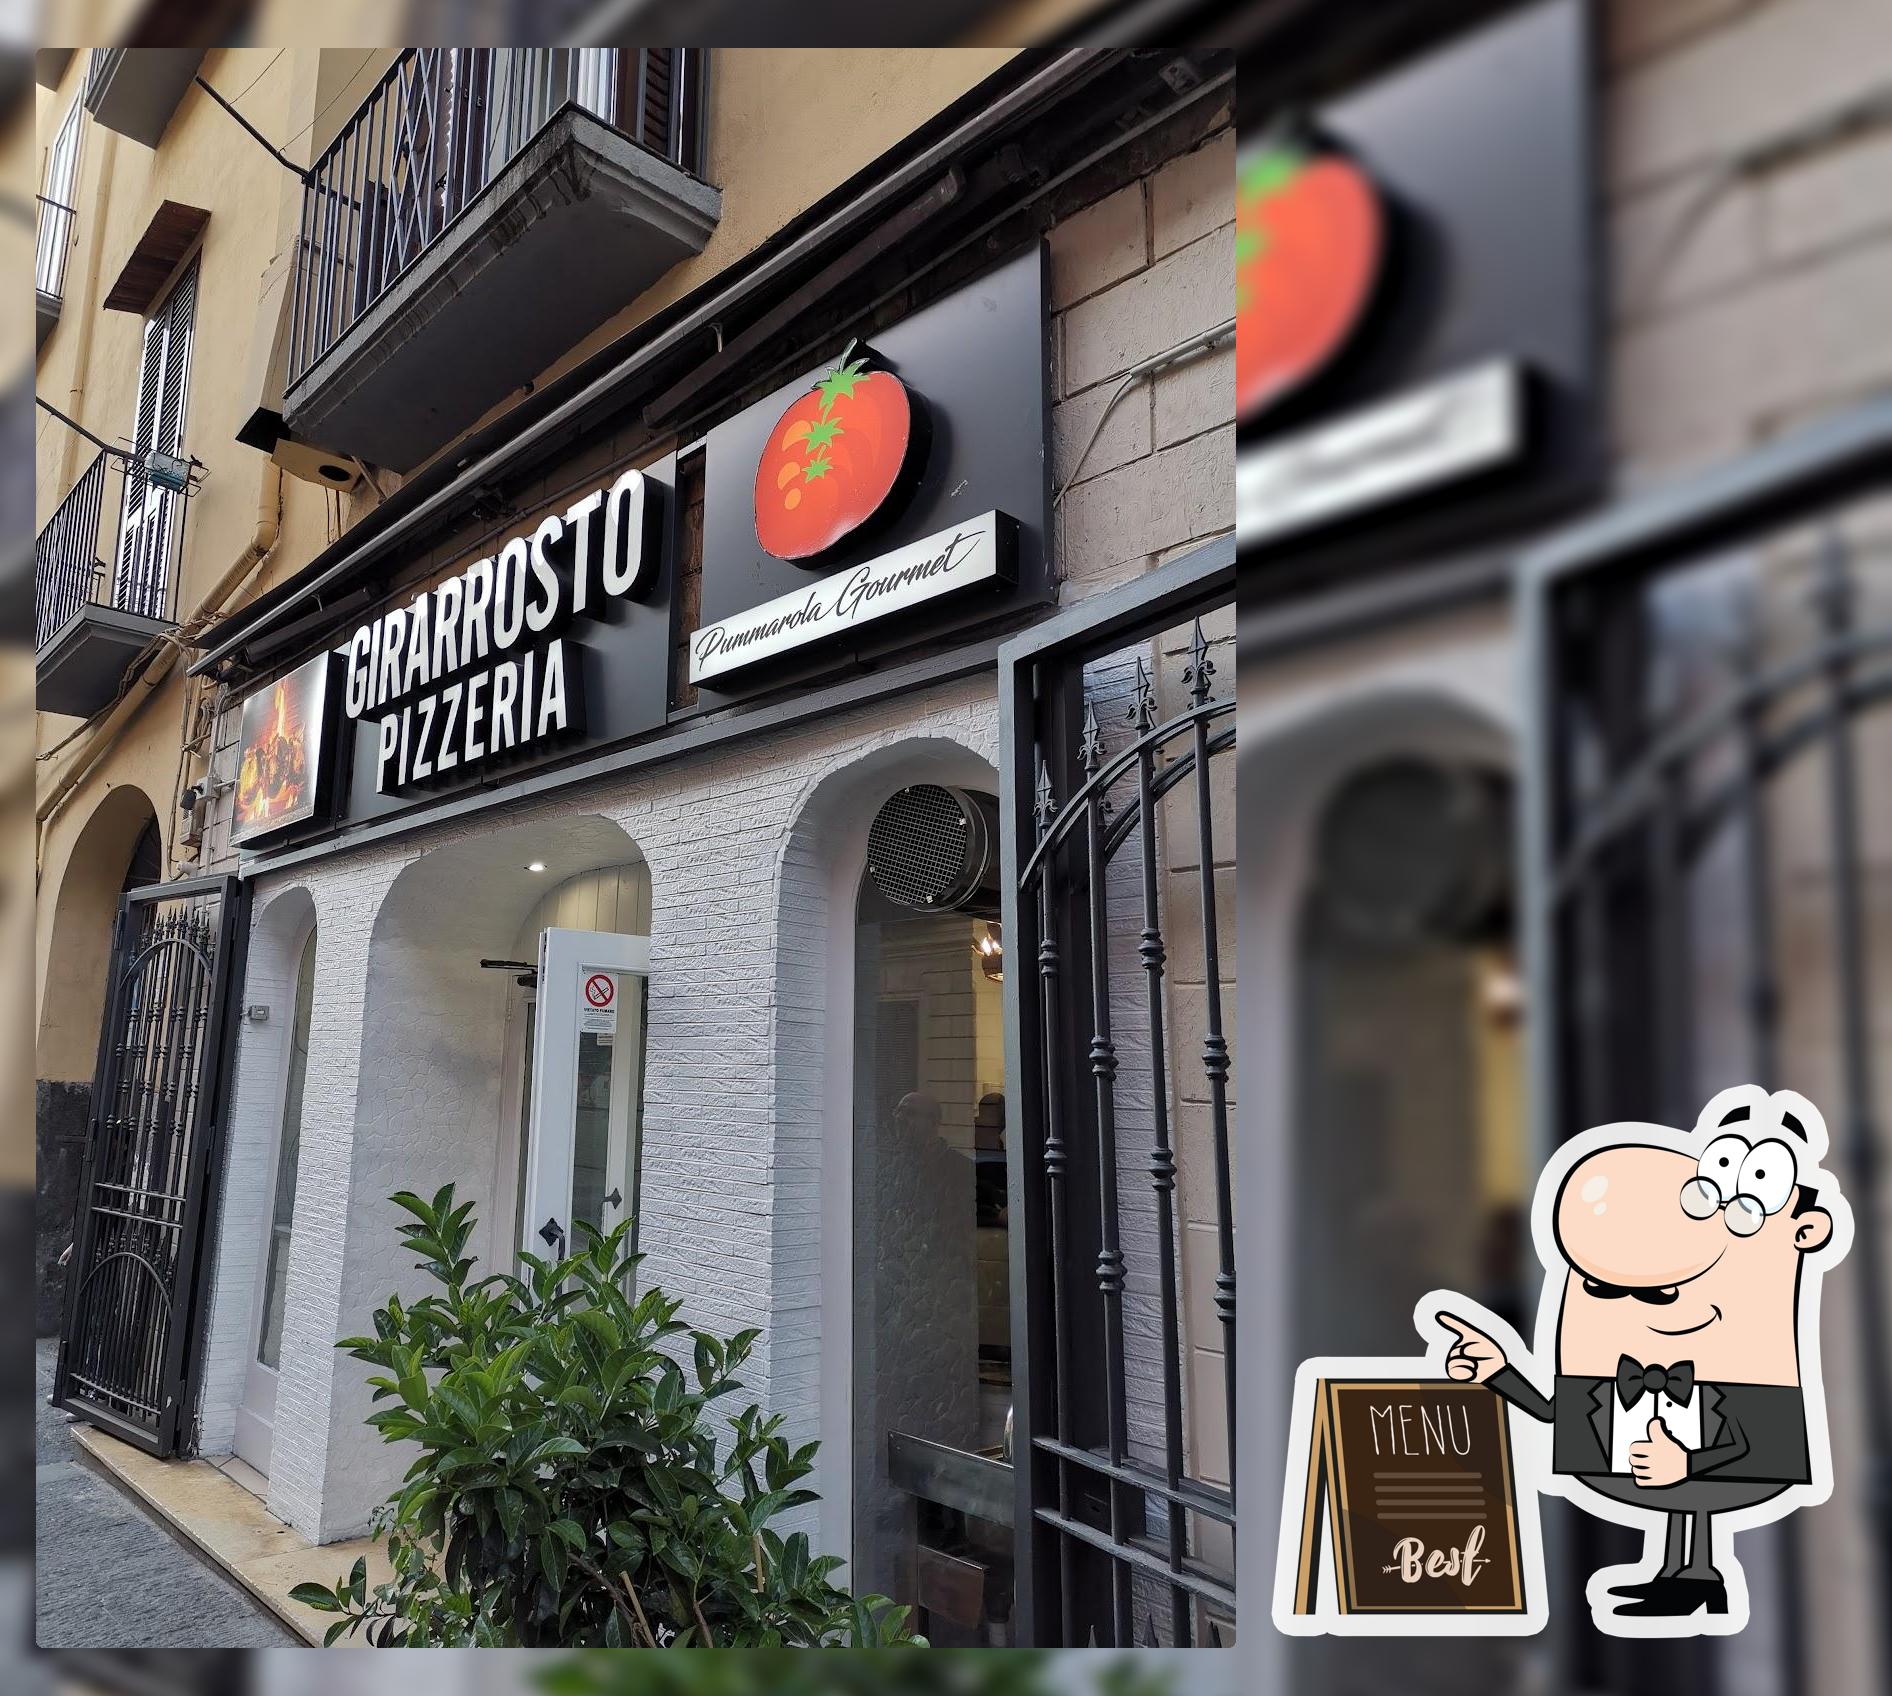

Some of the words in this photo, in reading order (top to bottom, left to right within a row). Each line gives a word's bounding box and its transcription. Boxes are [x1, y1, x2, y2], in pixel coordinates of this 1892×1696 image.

[345, 469, 645, 719] GIRARROSTO
[695, 591, 826, 671] Pummarola
[828, 530, 986, 619] Gourmet
[377, 638, 567, 794] PIZZERIA
